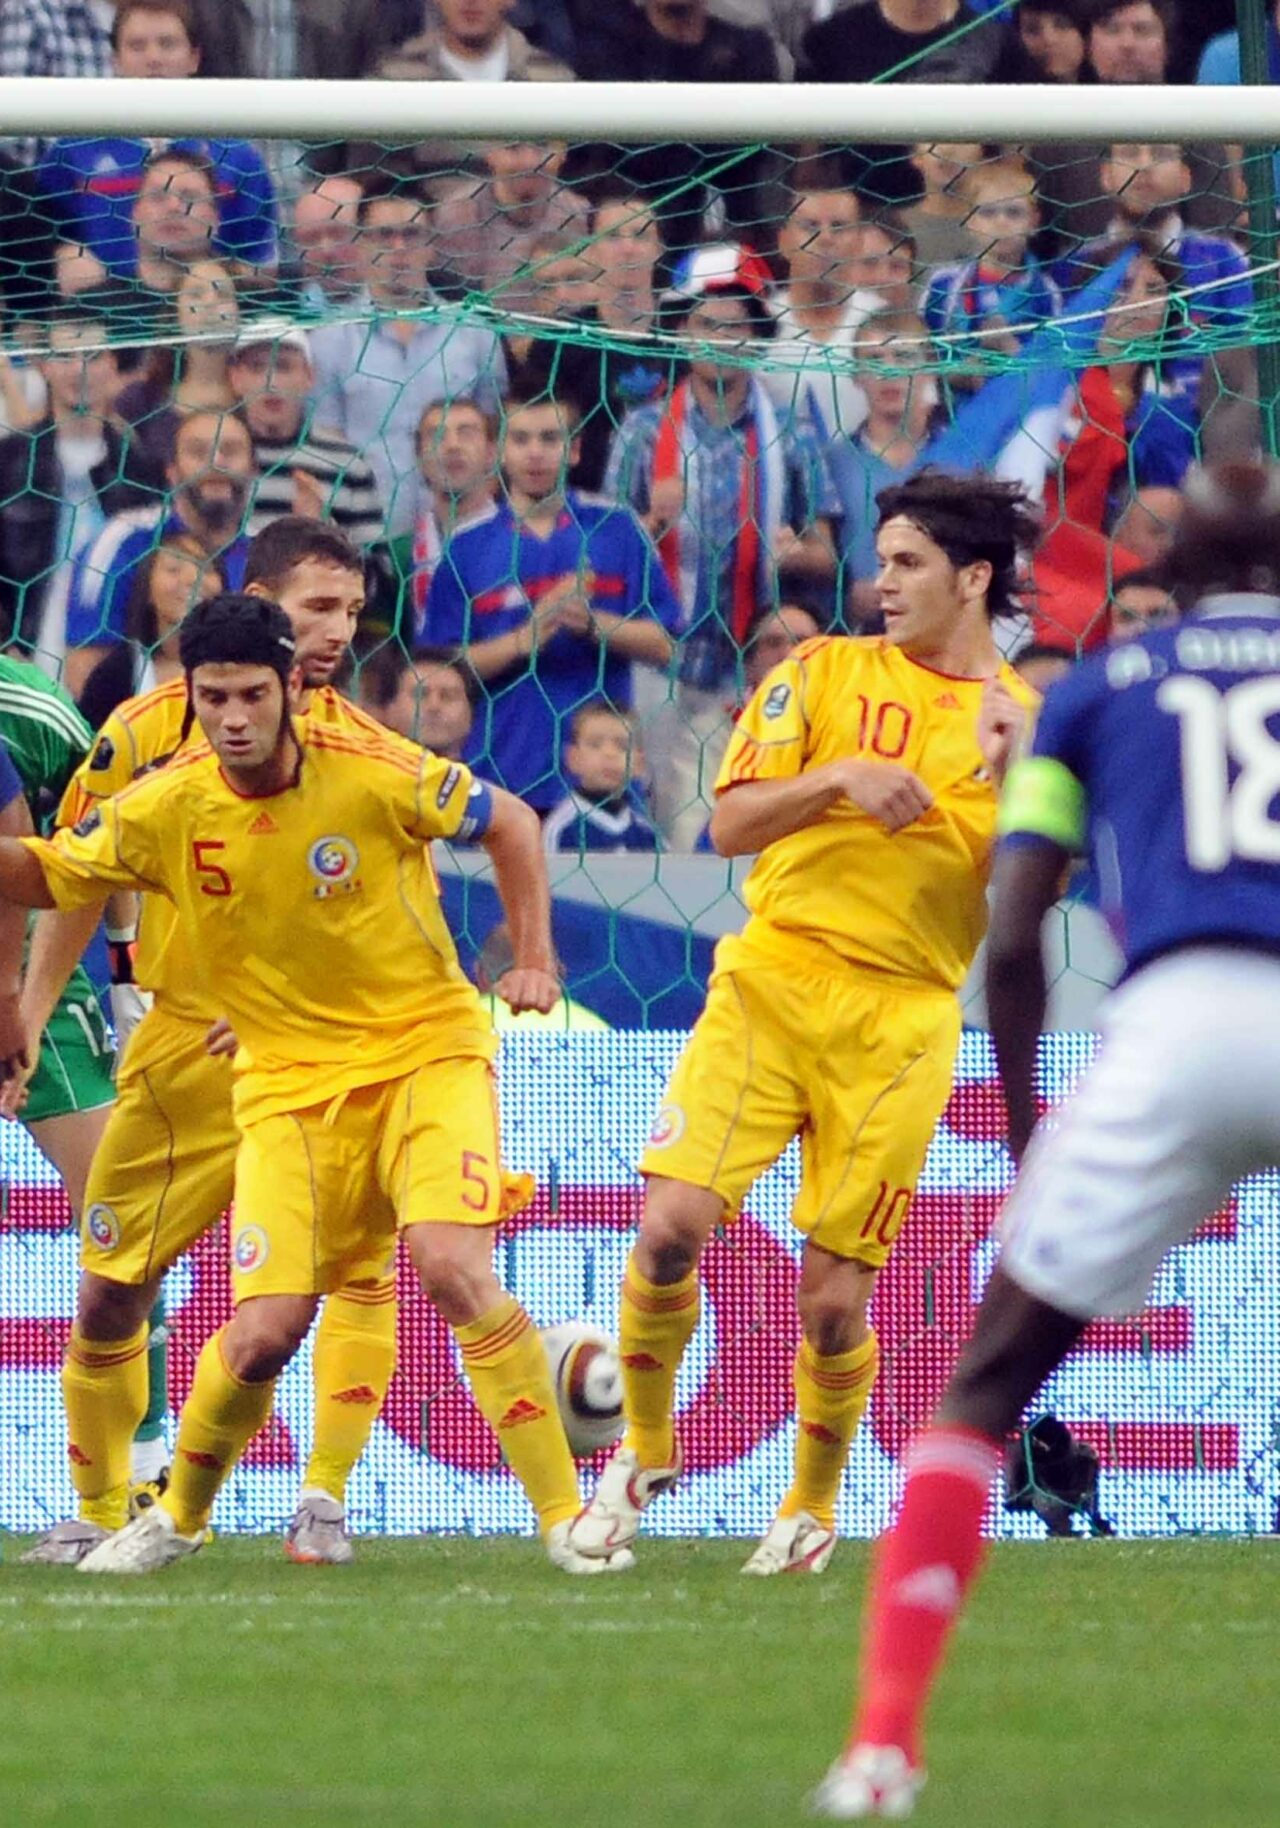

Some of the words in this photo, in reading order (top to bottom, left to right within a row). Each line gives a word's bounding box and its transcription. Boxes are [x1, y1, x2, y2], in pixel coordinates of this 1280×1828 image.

[857, 693, 912, 759] 10
[1154, 673, 1280, 873] 18
[192, 840, 233, 897] 5
[461, 1150, 489, 1212] 5
[859, 1181, 913, 1246] 10
